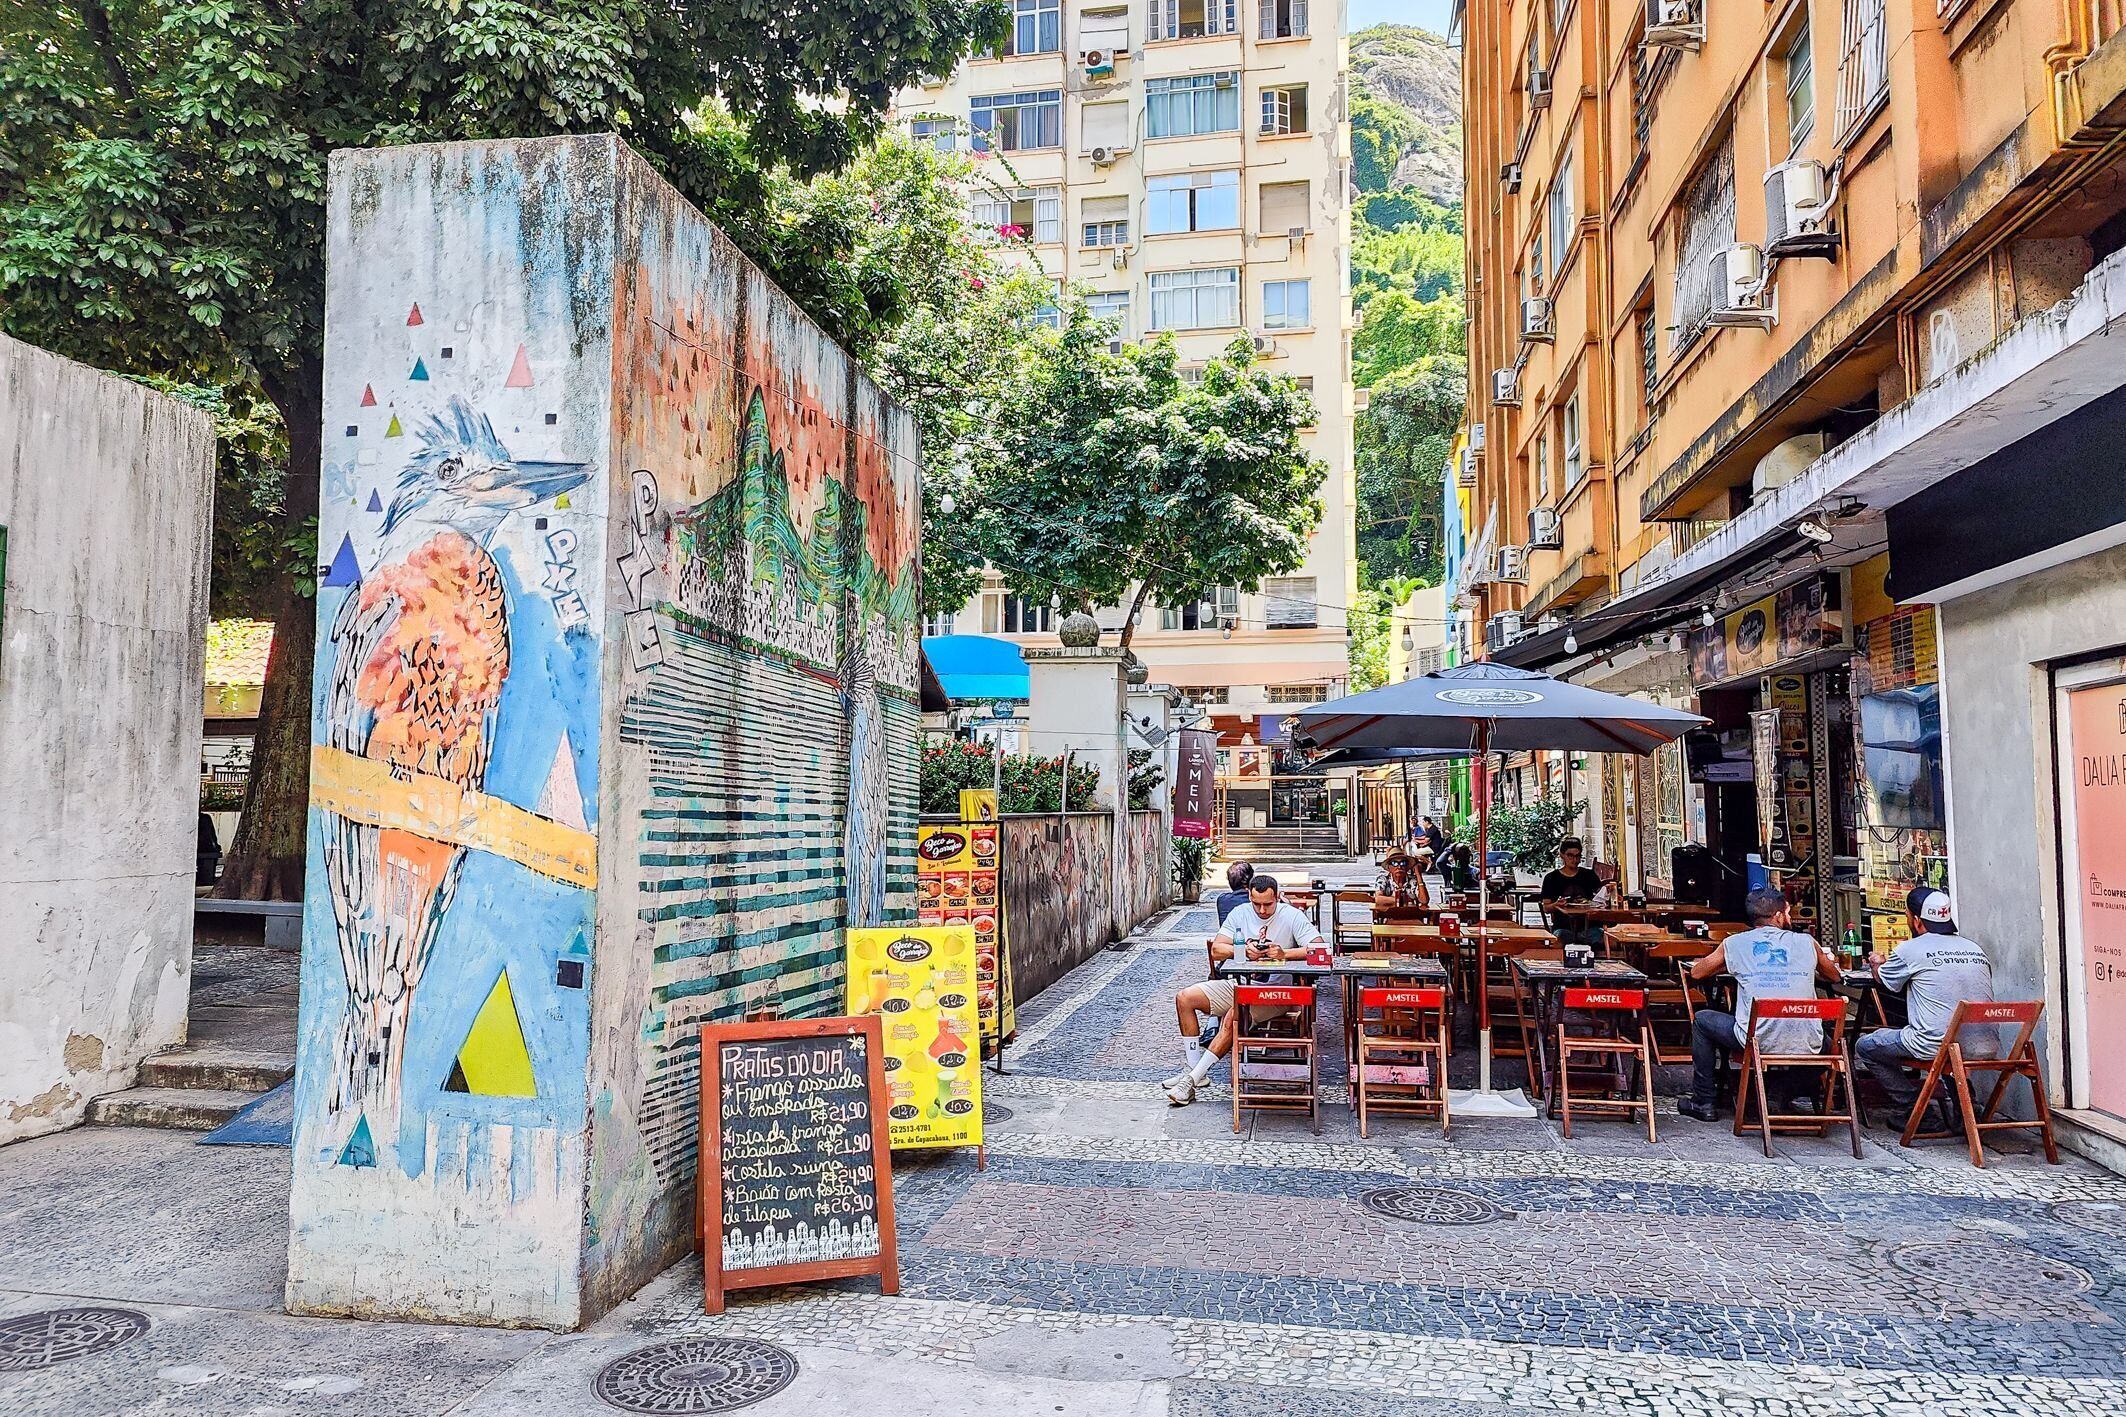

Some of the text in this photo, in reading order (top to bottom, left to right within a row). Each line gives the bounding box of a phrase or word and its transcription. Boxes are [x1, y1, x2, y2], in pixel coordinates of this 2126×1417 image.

[2083, 755, 2120, 787] DALIA
[2093, 945, 2122, 957] SIGA-NOS
[1258, 991, 1293, 1000] AMSTEL
[1385, 993, 1421, 1003] AMSTEL
[1585, 994, 1622, 1004] AMSTEL
[1781, 1005, 1820, 1014] AMSTEL
[1984, 1008, 2016, 1018] AMSTEL
[721, 1046, 844, 1080] PRATOS DO DIA
[735, 1080, 795, 1105] Frango
[797, 1066, 866, 1094] assado
[721, 1103, 744, 1121] ou
[765, 1119, 787, 1143] de
[791, 1123, 848, 1144] frango
[899, 1124, 932, 1134] 2513-4781
[952, 1132, 968, 1140] 1100
[731, 1159, 787, 1182] Costela
[722, 1204, 741, 1225] de
